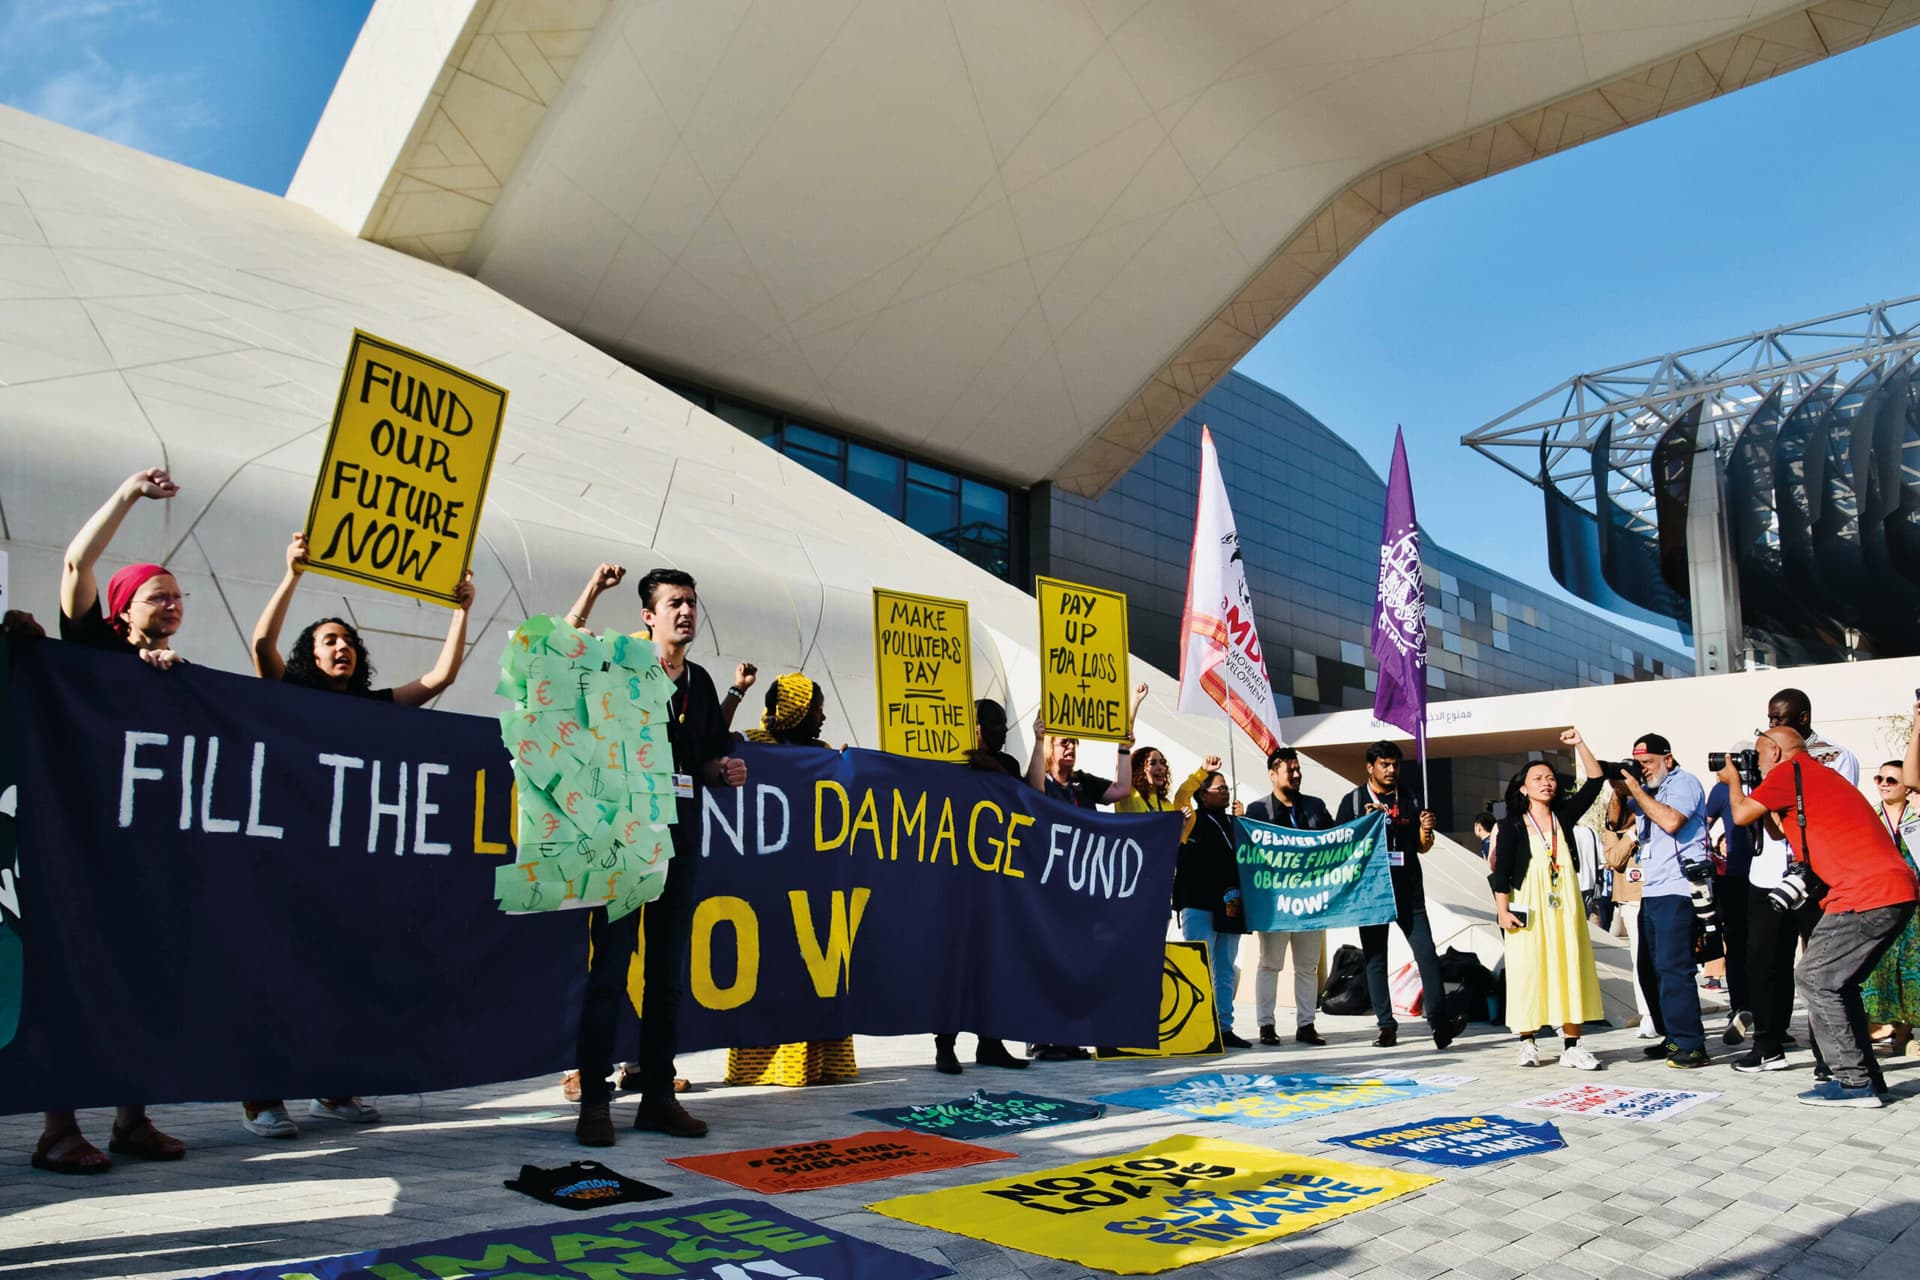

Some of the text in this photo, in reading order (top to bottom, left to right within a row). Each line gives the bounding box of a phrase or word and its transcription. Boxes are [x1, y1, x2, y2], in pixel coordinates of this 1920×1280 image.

[360, 359, 473, 437] FUND
[370, 418, 458, 483] OUR
[331, 460, 464, 539] FUTURE
[320, 512, 442, 581] NOW
[890, 602, 947, 631] MAKE
[1060, 592, 1096, 618] PAY
[882, 629, 961, 664] POLLUTERS
[1064, 620, 1097, 645] UP
[904, 661, 941, 685] PAY
[1049, 647, 1117, 684] FOR LOSS
[1226, 658, 1266, 704] VELOPMENT
[889, 702, 965, 727] FILL THE
[1049, 692, 1121, 732] DAMAGE
[905, 730, 960, 754] FUND
[118, 730, 284, 839] FILL
[319, 752, 452, 856] THE
[701, 784, 790, 859] ND
[814, 780, 1036, 879] DAMAGE
[1040, 822, 1144, 899] FUND
[1236, 838, 1374, 869] CLIMATE FINANCE
[1251, 828, 1355, 847] DELIVER YOUR
[1254, 863, 1362, 889] OBLIGATIONS
[1277, 891, 1329, 916] NOW!
[748, 1143, 909, 1168] FOSSIL FUEL
[982, 1158, 1179, 1203] NO TO
[1023, 1162, 1236, 1215] LOANS
[1163, 1188, 1217, 1208] AS
[1104, 1174, 1332, 1235] CLIMATE
[1146, 1181, 1385, 1245] FINANCE
